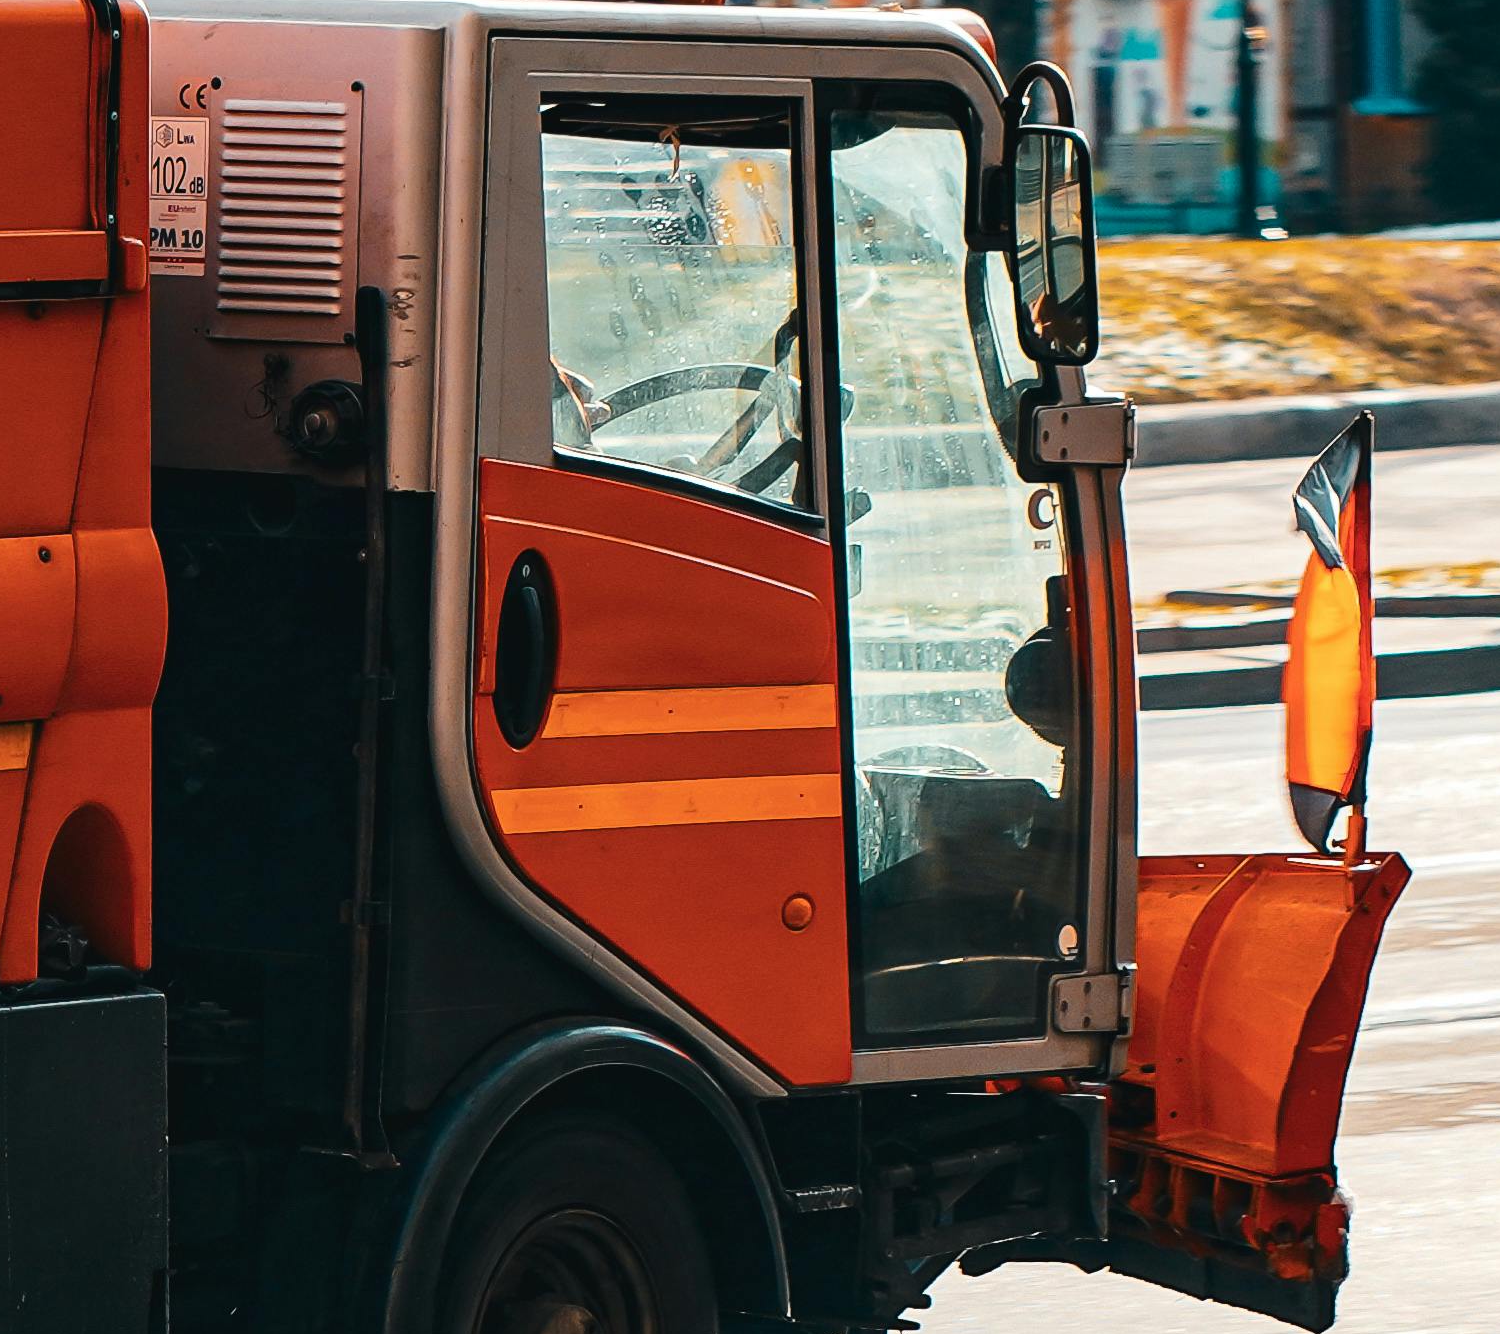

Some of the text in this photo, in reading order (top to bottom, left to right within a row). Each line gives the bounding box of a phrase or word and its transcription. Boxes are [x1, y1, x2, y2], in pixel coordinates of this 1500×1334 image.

[152, 156, 204, 194] 102 dB
[150, 228, 204, 249] PM 10
